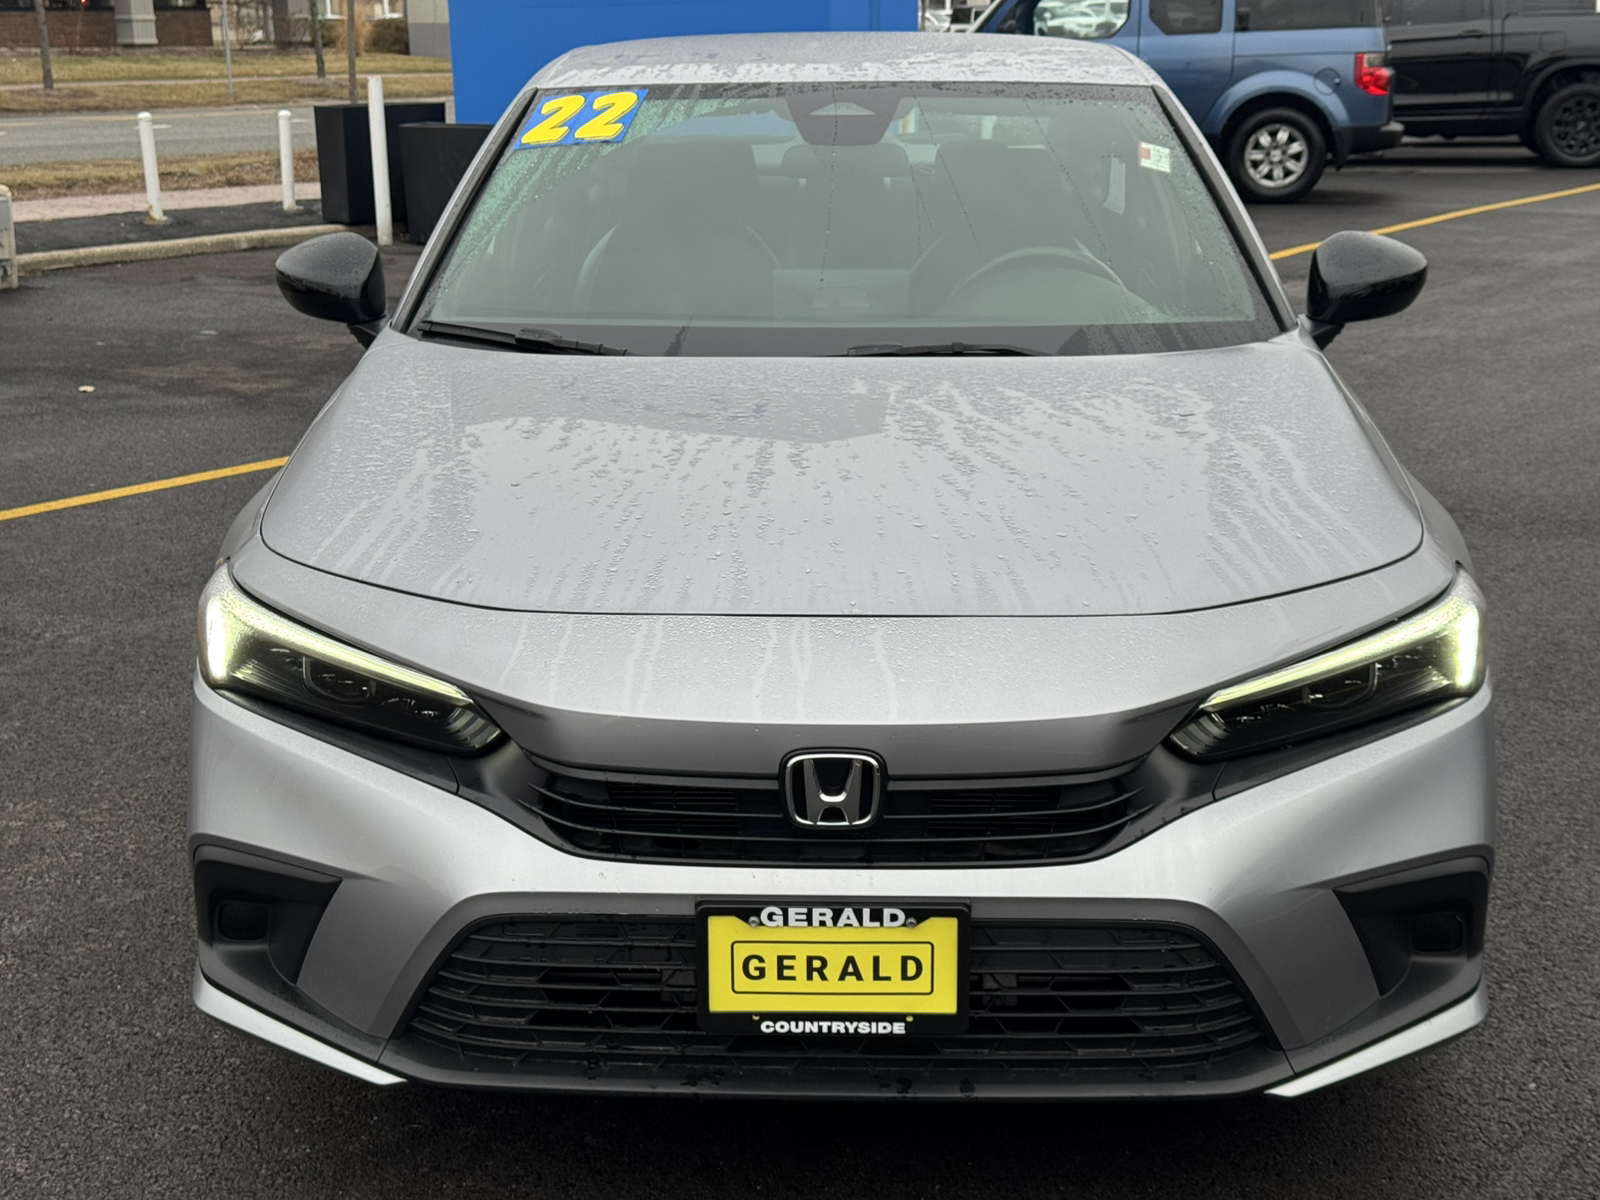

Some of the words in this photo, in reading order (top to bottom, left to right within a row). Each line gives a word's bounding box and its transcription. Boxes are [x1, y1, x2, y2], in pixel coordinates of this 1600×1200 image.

[521, 91, 639, 145] 22
[760, 906, 906, 928] GERALD
[742, 954, 923, 981] GERALD
[760, 1020, 906, 1035] COUNTRYSIDE
